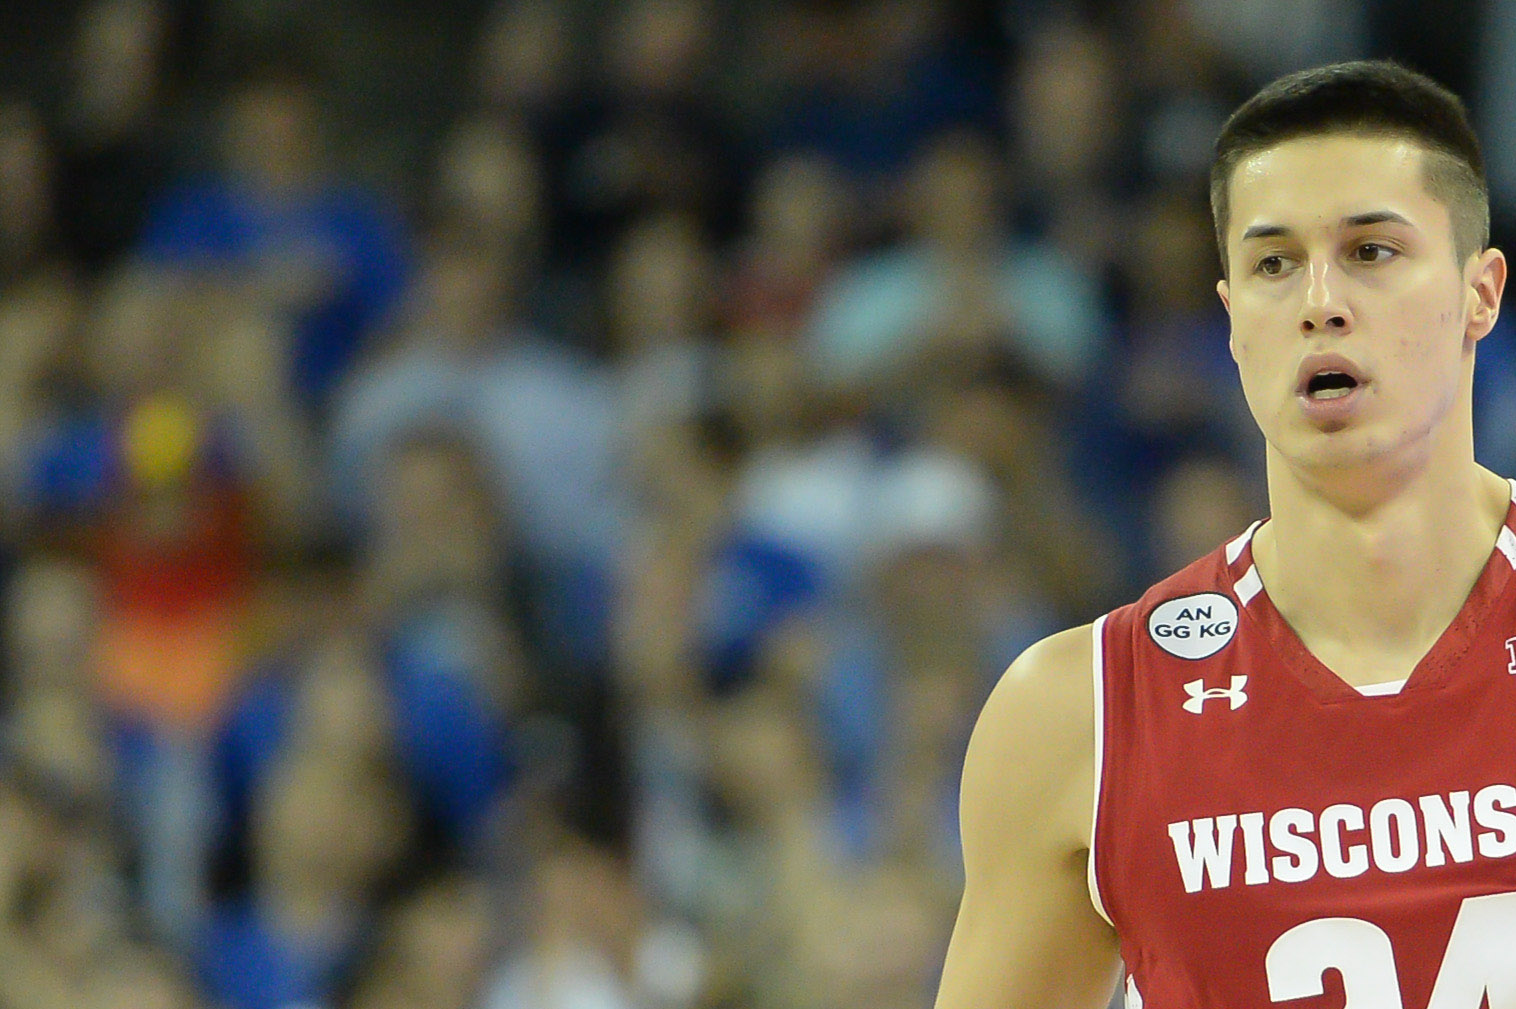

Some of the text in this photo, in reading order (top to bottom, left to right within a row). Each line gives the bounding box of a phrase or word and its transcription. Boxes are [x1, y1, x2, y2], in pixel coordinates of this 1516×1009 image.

[1176, 606, 1212, 620] AN
[1154, 621, 1231, 638] GG KG
